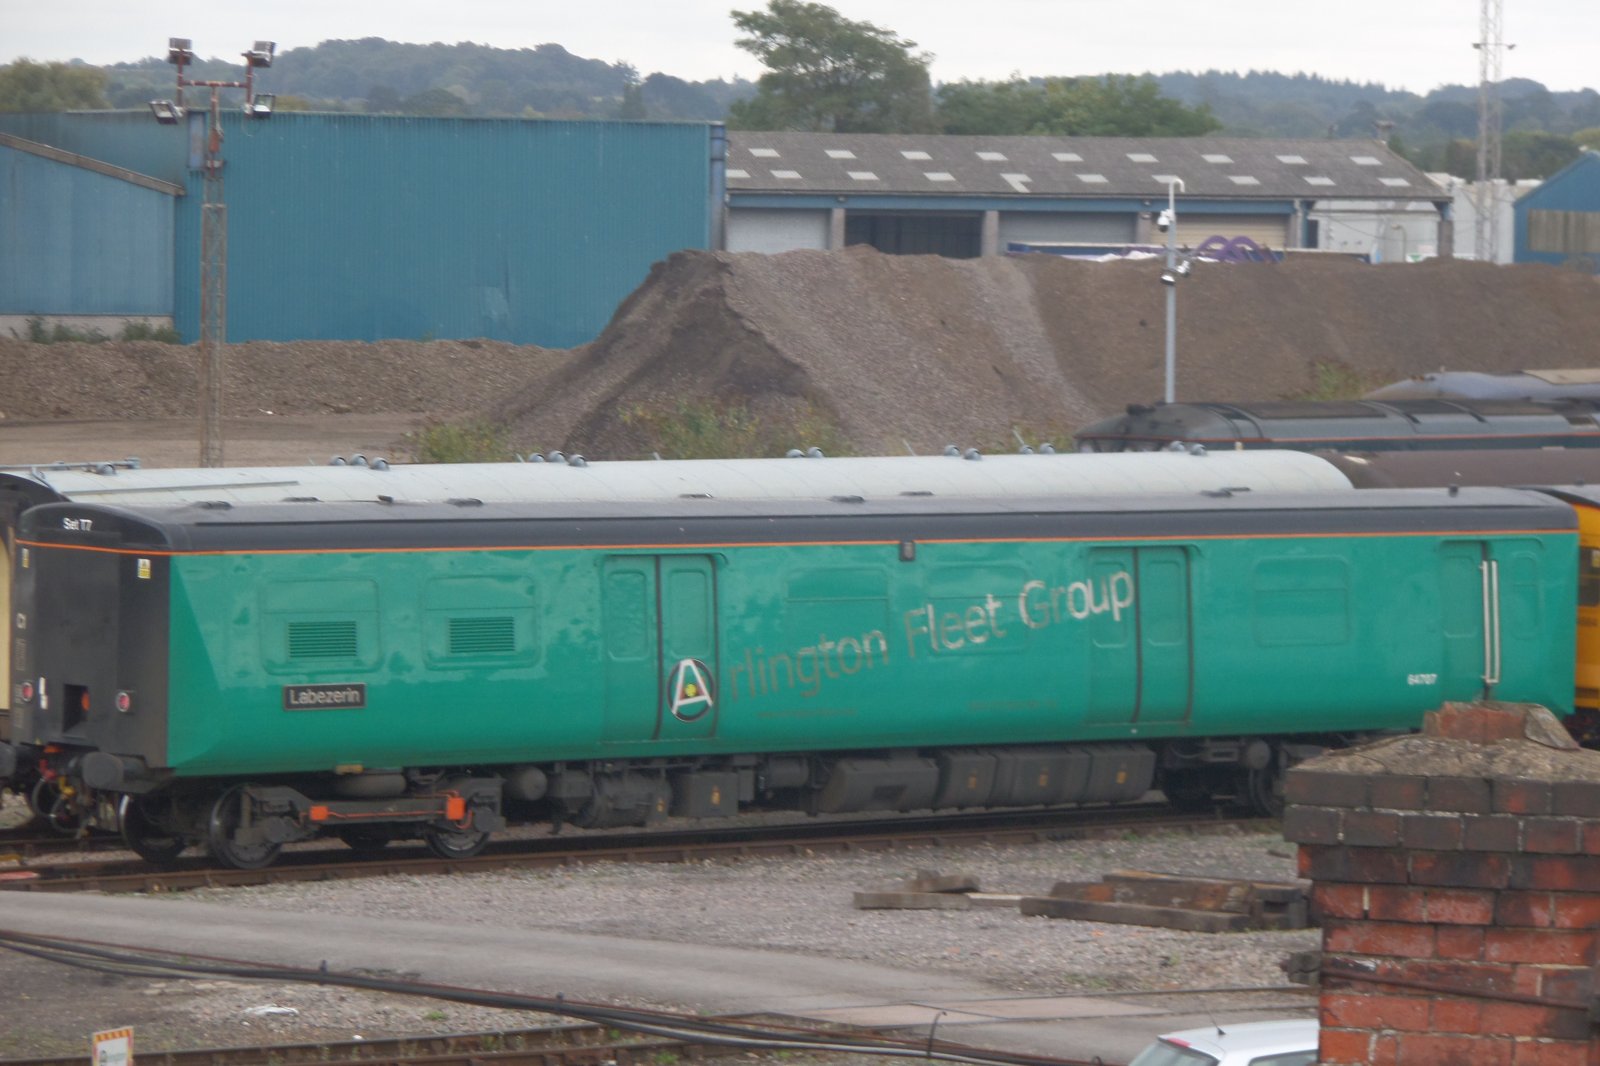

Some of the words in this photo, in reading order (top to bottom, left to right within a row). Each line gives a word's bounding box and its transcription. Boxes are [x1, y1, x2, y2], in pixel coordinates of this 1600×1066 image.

[63, 517, 79, 531] Set
[904, 592, 1008, 660] Fleet
[1018, 570, 1136, 630] Group
[289, 687, 361, 705] Labezerin
